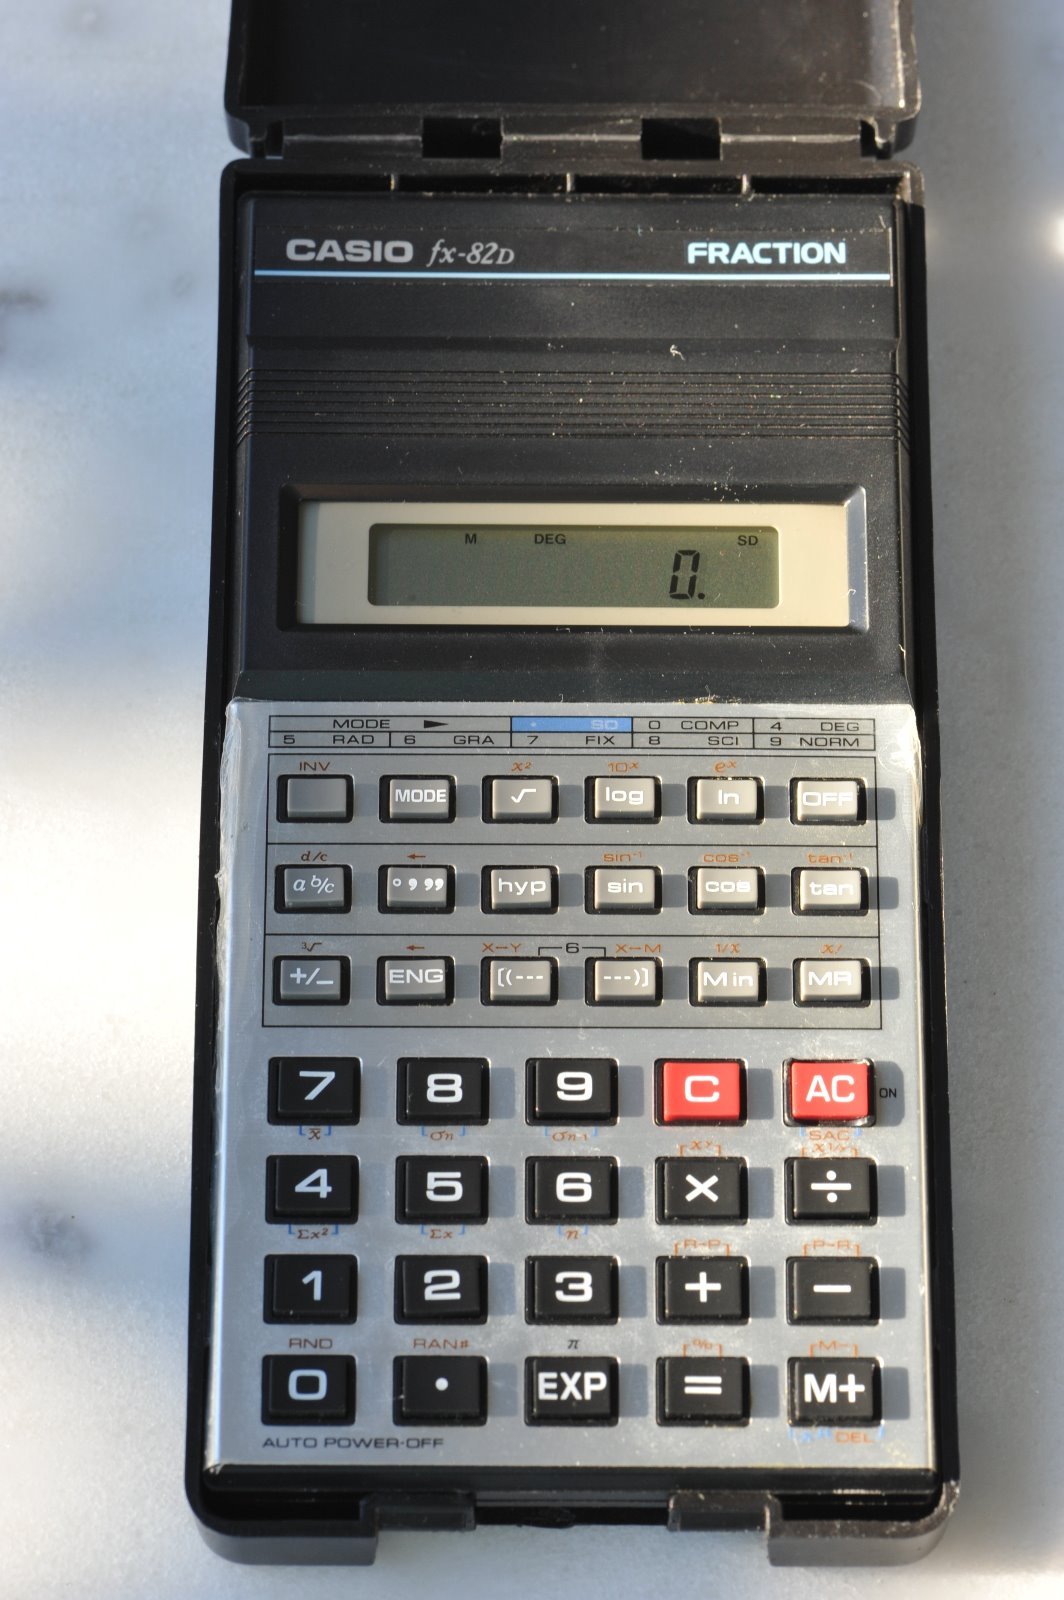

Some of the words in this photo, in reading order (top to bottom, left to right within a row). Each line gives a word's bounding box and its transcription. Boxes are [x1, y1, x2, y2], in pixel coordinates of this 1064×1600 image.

[286, 239, 412, 261] CASIO
[427, 239, 515, 267] fx-82D
[687, 242, 847, 264] FRACTION
[465, 533, 477, 545] M
[534, 533, 566, 545] DEG
[737, 535, 759, 547] SD
[333, 719, 391, 729] MODE
[681, 720, 739, 730] COMP
[770, 721, 783, 731] 4
[820, 722, 860, 731] DEG
[283, 735, 296, 745] 5
[332, 735, 374, 745] RAD
[404, 735, 416, 745] 6
[453, 735, 495, 745] GRA
[527, 735, 538, 745] 7
[585, 735, 615, 745] FIX
[648, 736, 661, 746] 8
[708, 736, 739, 746] SCI
[770, 736, 782, 746] 9
[800, 737, 860, 747] NORM
[299, 761, 331, 771] INV
[395, 789, 447, 803] MODE
[605, 787, 644, 805] log
[802, 791, 854, 806] OFF
[498, 878, 547, 896] hyp
[607, 880, 644, 893] sin
[705, 880, 752, 893] cos
[809, 881, 855, 896] tan
[565, 943, 579, 953] 6
[389, 968, 444, 984] ENG
[808, 971, 852, 986] MR
[299, 1071, 336, 1101] 7
[426, 1073, 463, 1103] 8
[556, 1071, 593, 1102] 9
[684, 1075, 720, 1103] C
[805, 1074, 855, 1103] AC
[879, 1087, 897, 1099] ON
[809, 1130, 850, 1141] SAC
[294, 1168, 332, 1199] 4
[426, 1171, 463, 1202] 5
[555, 1172, 592, 1203] 6
[302, 1270, 323, 1301] 1
[424, 1269, 461, 1301] 2
[555, 1271, 593, 1302] 3
[289, 1338, 333, 1349] RND
[413, 1338, 471, 1349] RAN#
[288, 1369, 328, 1400] 0
[538, 1371, 607, 1401] EXP
[804, 1373, 865, 1403] M+
[262, 1437, 318, 1449] AUTO
[323, 1437, 445, 1449] POWER-OFF
[834, 1431, 874, 1443] DEL
